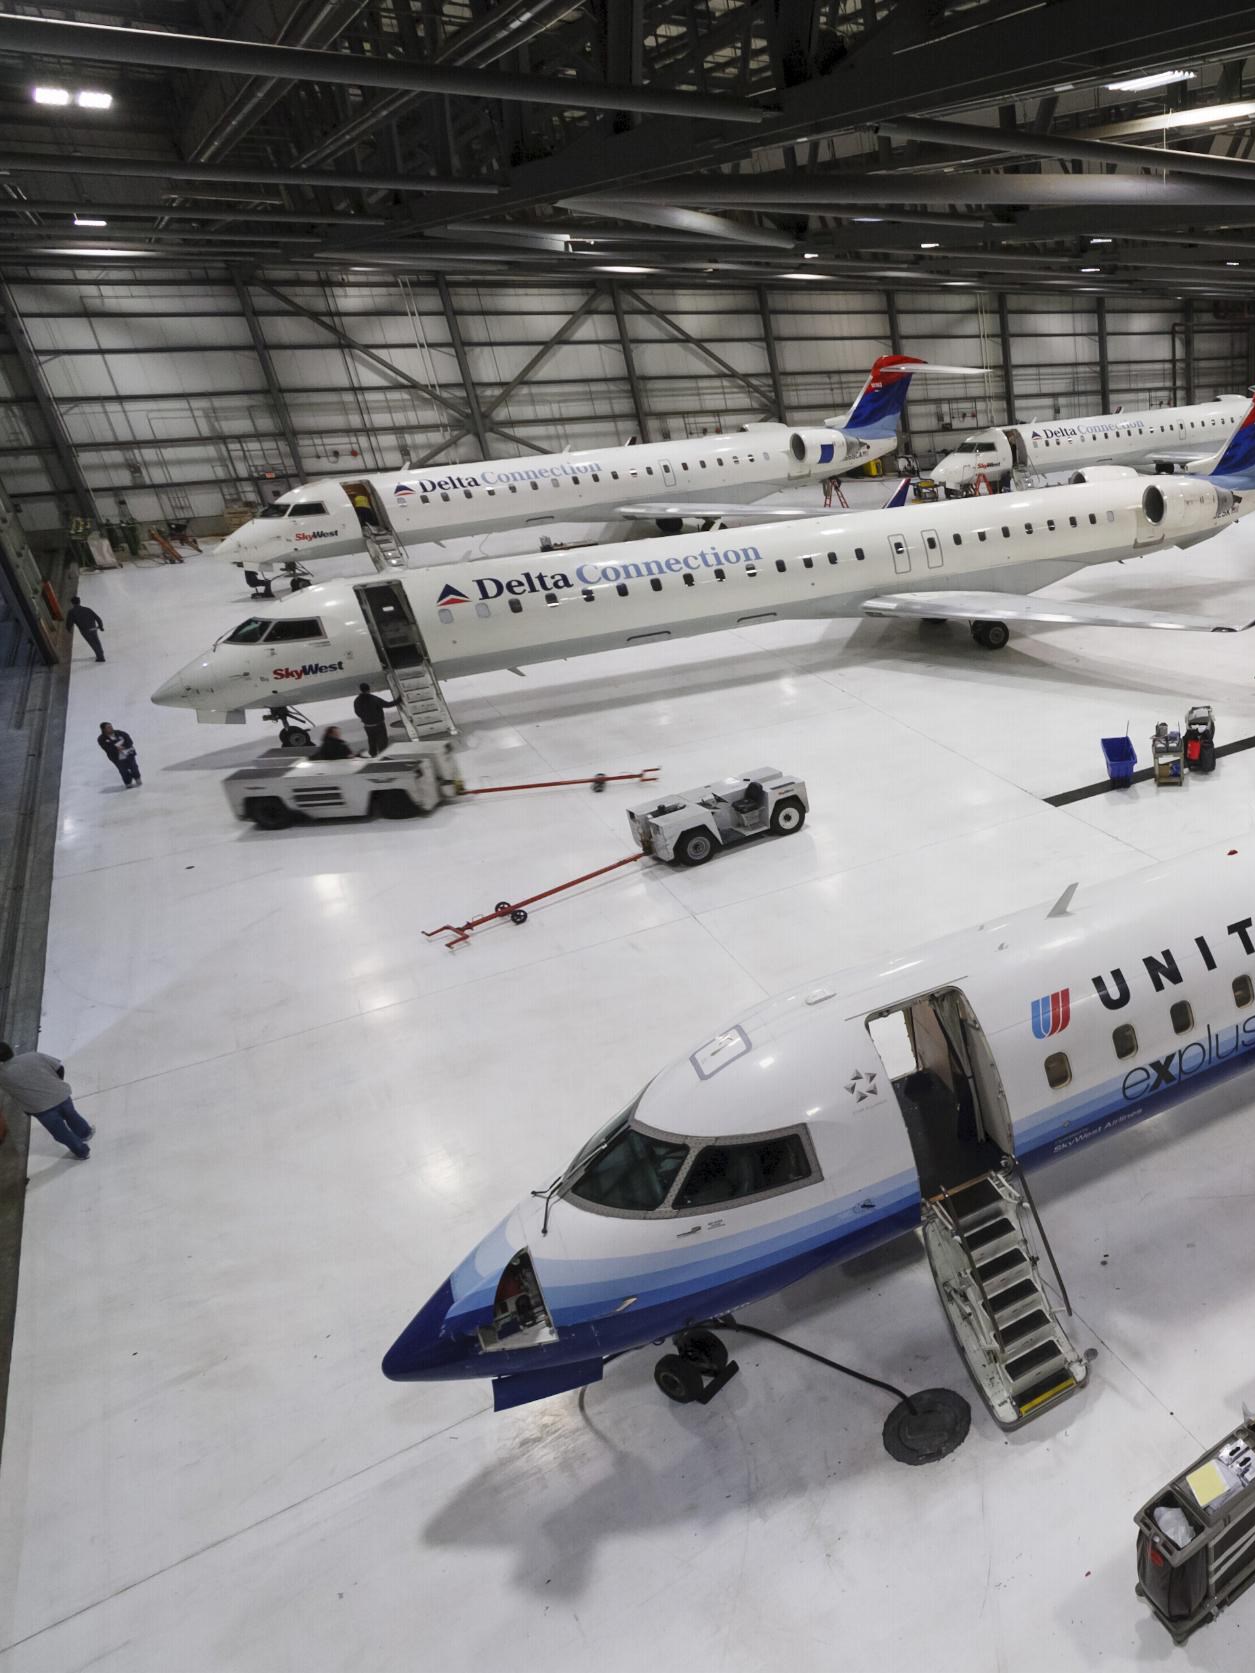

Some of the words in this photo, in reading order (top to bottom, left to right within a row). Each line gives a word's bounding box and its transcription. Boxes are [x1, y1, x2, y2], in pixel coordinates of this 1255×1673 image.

[1043, 423, 1077, 440] Delta
[1077, 419, 1145, 435] Connection
[419, 475, 481, 494] Delta
[481, 462, 602, 486] Connection
[295, 529, 339, 542] SkyWest
[472, 571, 574, 601] Delta
[576, 545, 763, 585] Connection
[272, 660, 344, 680] SkyWest
[1053, 1127, 1102, 1152] SkyWest
